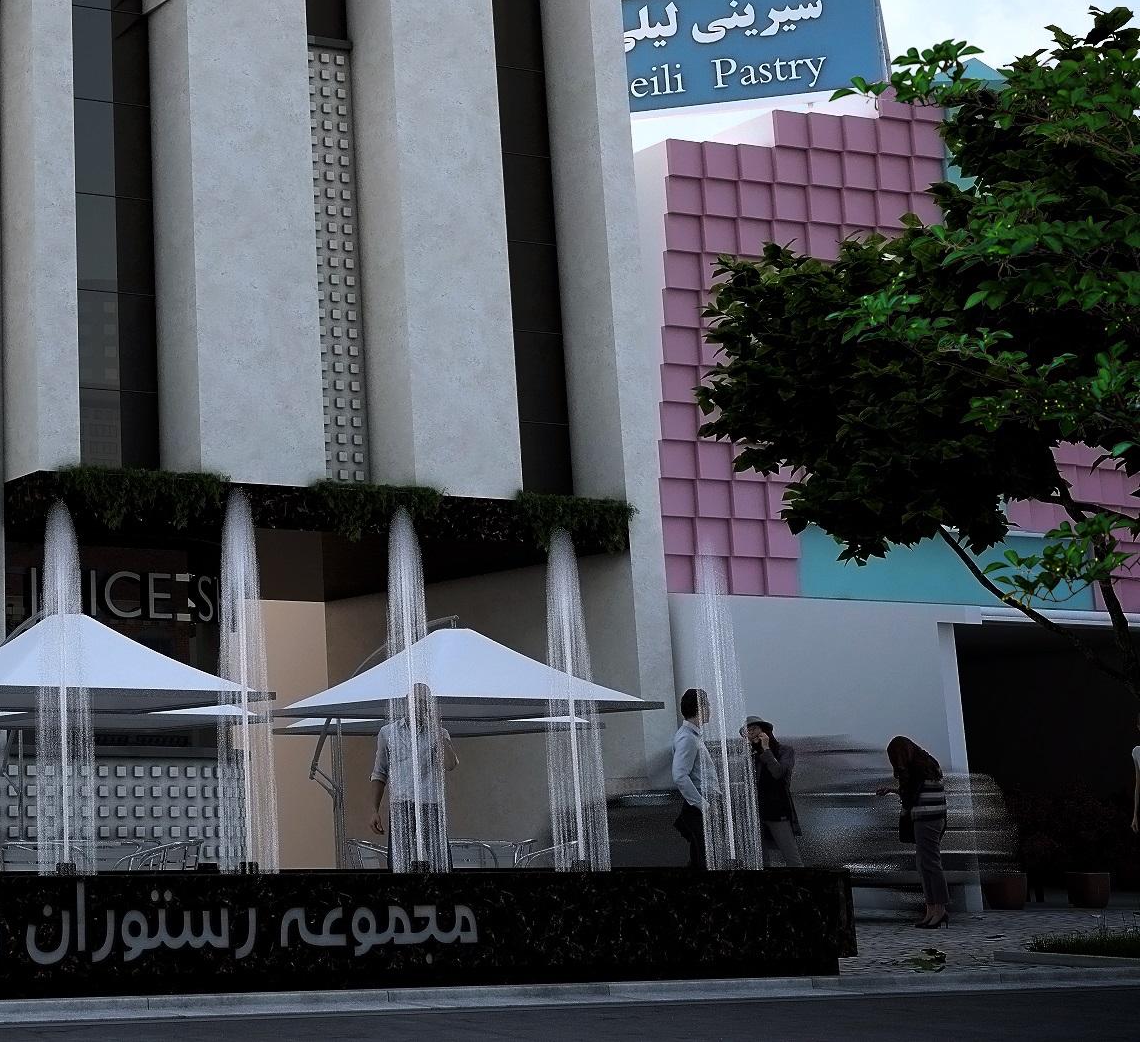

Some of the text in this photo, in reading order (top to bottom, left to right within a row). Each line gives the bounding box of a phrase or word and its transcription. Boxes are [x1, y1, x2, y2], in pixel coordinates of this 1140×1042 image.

[627, 56, 827, 98] eili Pastry
[25, 881, 257, 966] رستوران
[280, 904, 479, 964] مجموعه
